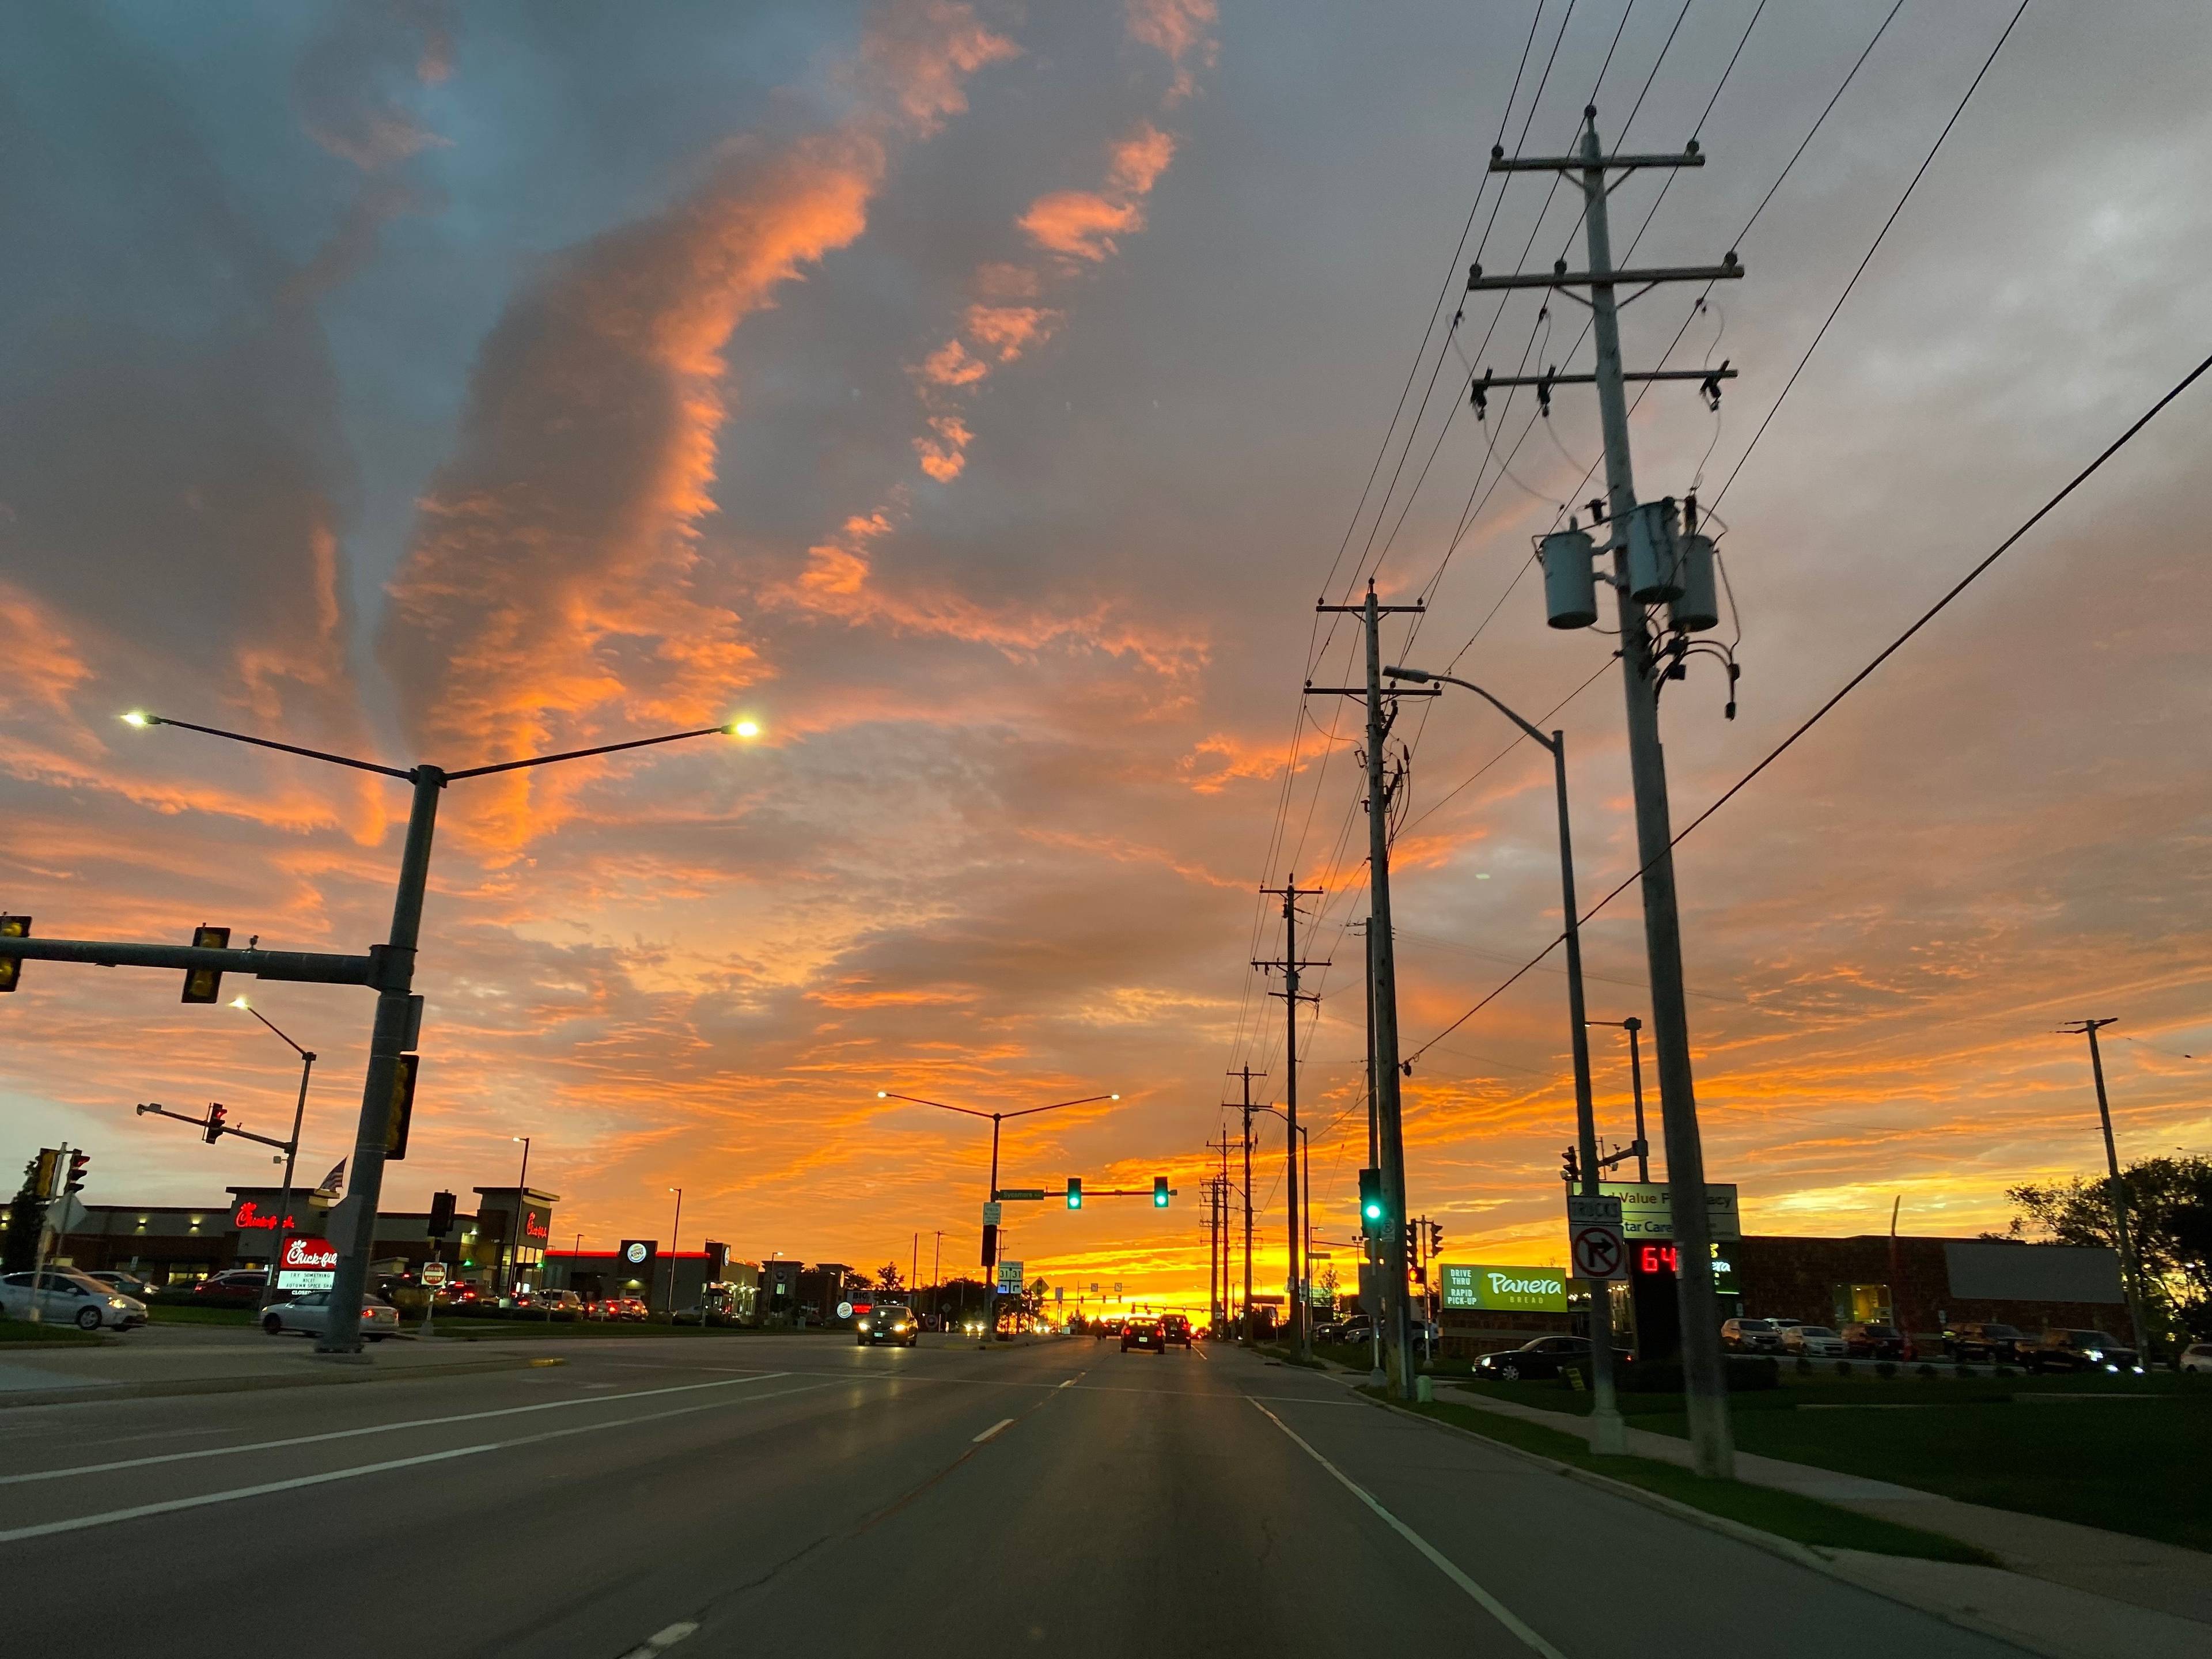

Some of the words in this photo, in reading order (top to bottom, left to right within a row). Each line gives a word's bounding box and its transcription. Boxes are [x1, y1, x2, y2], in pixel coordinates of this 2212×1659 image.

[1619, 1192, 1657, 1203] Value
[1623, 1222, 1641, 1232] tar
[1642, 1247, 1677, 1272] 64
[1450, 1269, 1472, 1278] DRIVE
[1452, 1277, 1471, 1285] THRU
[1487, 1272, 1562, 1295] Panera
[1451, 1289, 1473, 1297] RAPID
[1447, 1297, 1477, 1305] PICK-UP
[1509, 1296, 1544, 1304] BREAD
